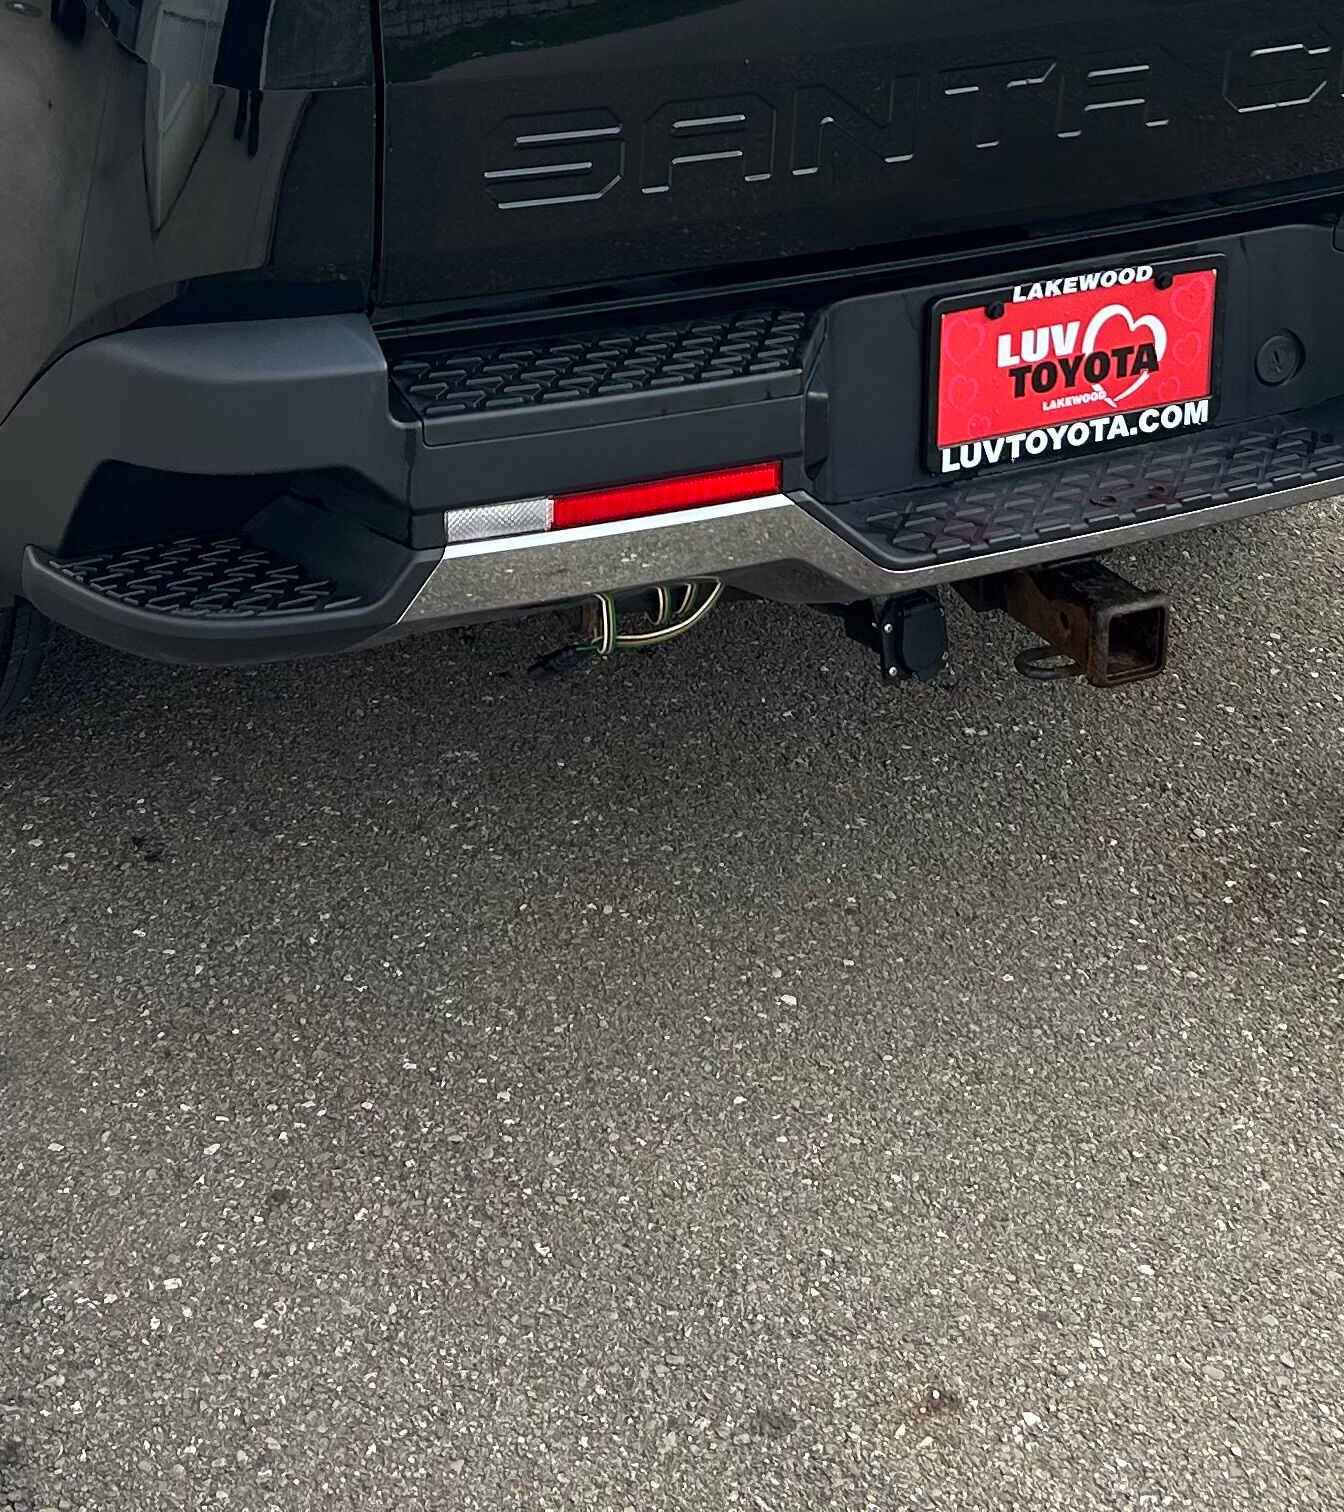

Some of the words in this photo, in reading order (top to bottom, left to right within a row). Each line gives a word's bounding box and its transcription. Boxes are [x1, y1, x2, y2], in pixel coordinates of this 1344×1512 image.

[482, 44, 1171, 210] SANTA
[1012, 264, 1154, 304] LAKEWOOD
[997, 320, 1081, 368] LUV
[1008, 343, 1160, 399] TOYOTA
[1042, 389, 1107, 413] LAKEWOOD
[941, 398, 1210, 474] LUVTOYOTA.COM
